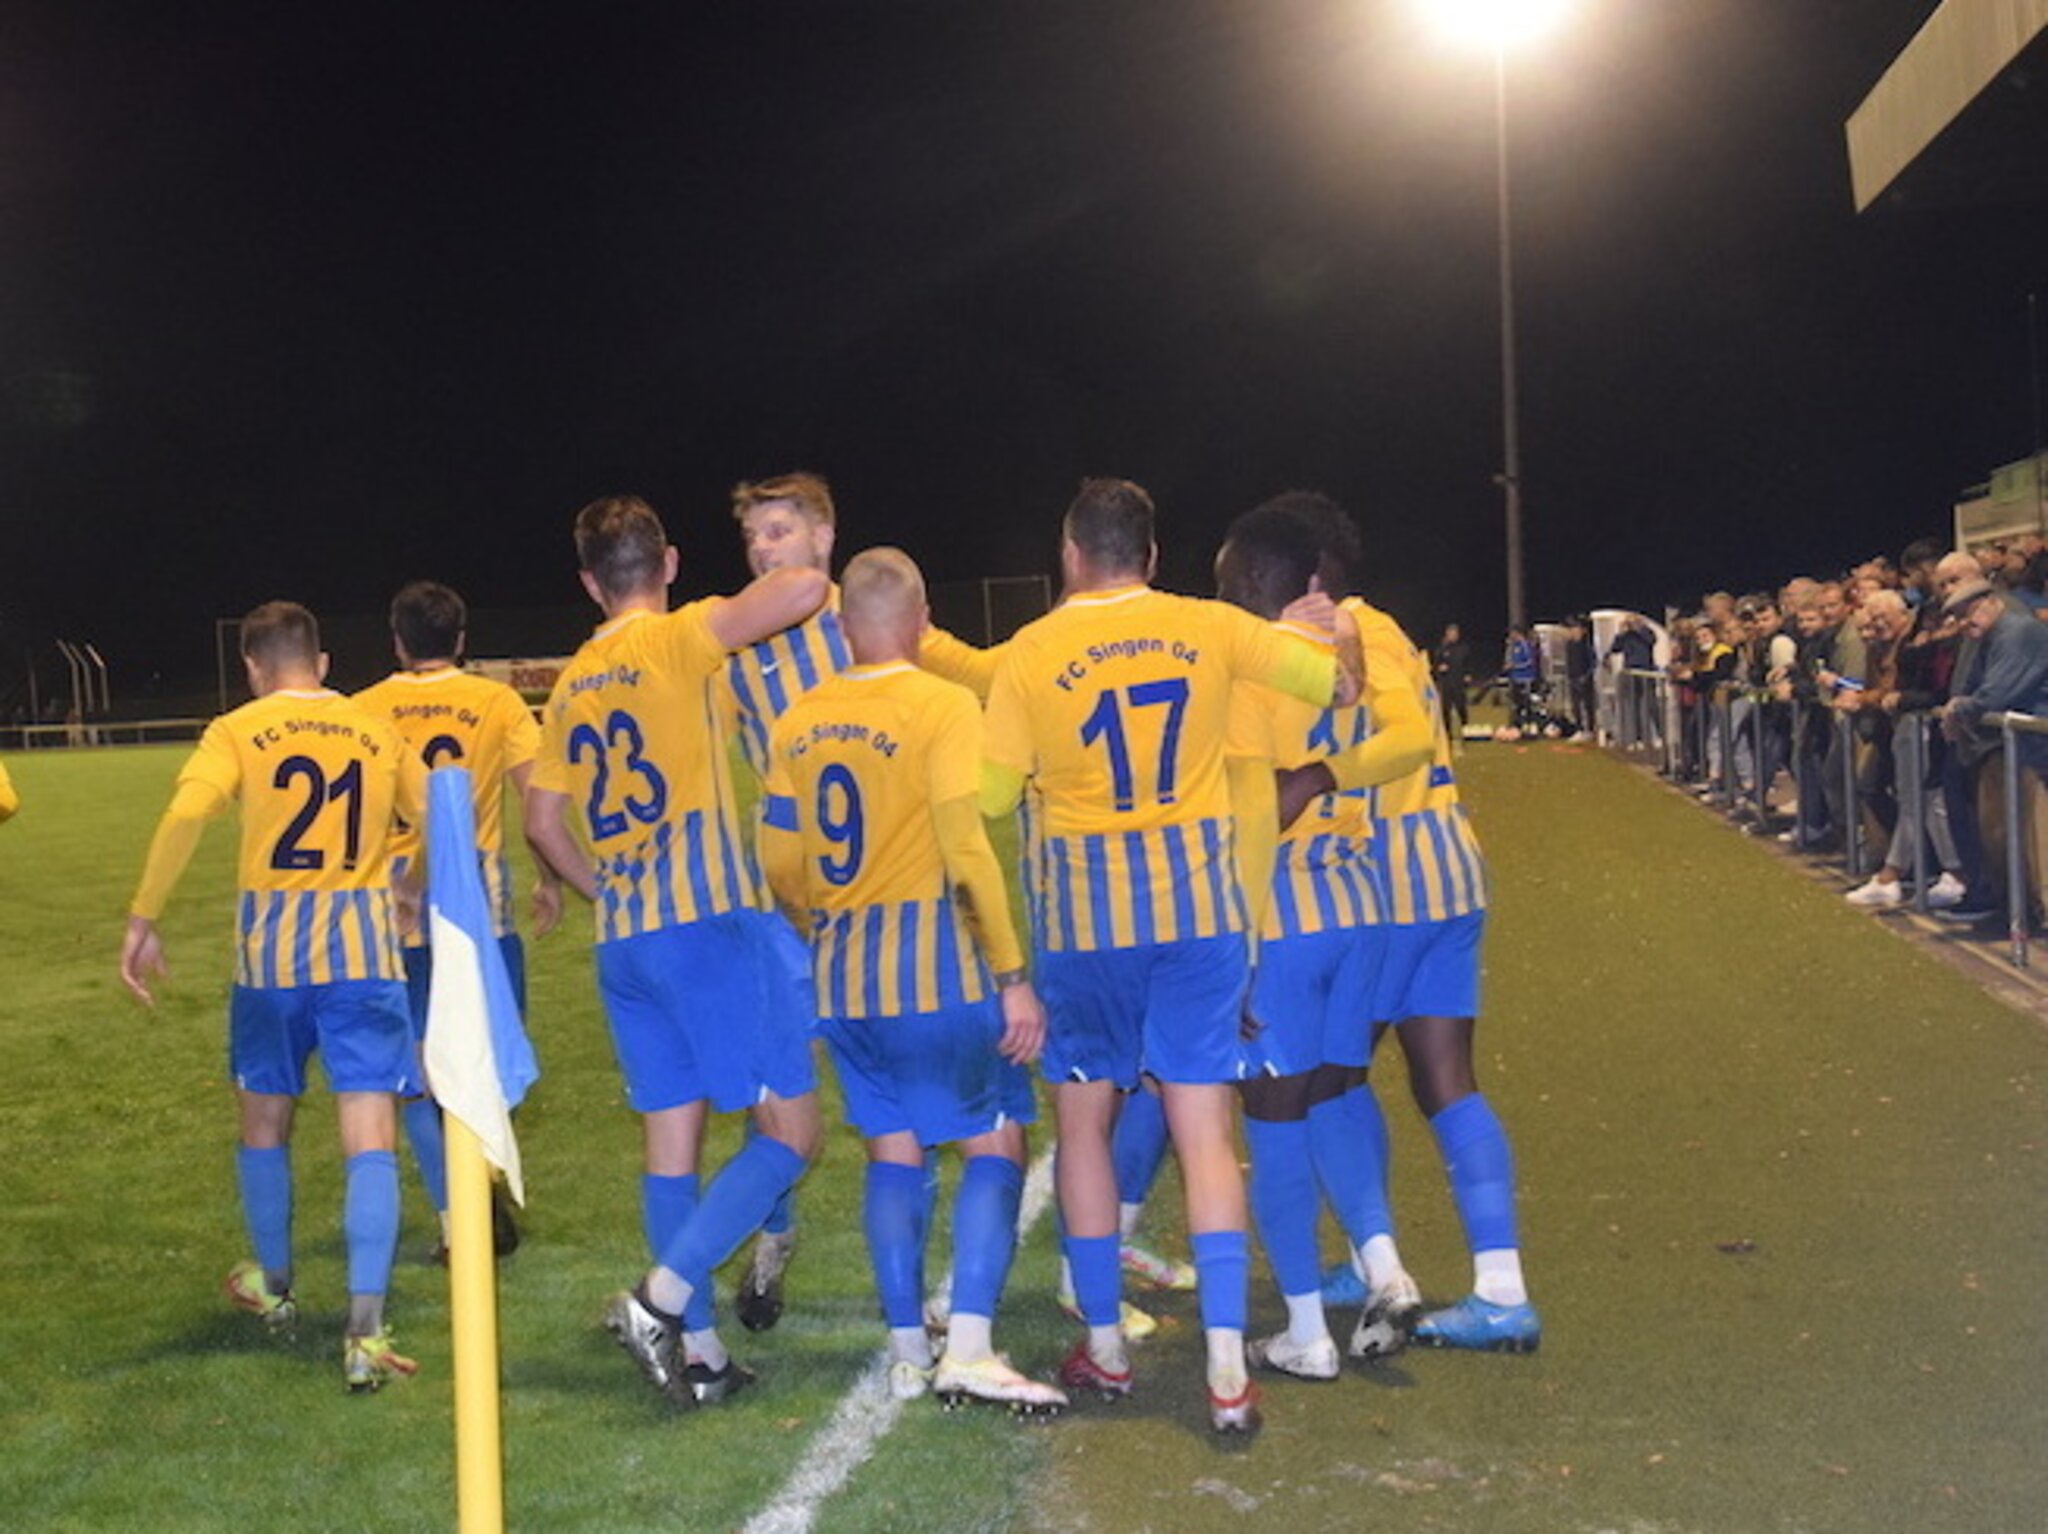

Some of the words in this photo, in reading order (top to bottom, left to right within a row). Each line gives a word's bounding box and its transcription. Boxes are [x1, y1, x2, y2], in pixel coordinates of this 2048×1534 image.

[1056, 660, 1086, 691] FC
[1087, 637, 1164, 664] Singen
[1172, 640, 1198, 666] 04
[253, 727, 280, 751] FC
[285, 718, 353, 735] Singen
[359, 733, 380, 757] 04
[392, 704, 452, 719] Singen
[457, 707, 479, 729] 04
[811, 722, 868, 743] Singen
[872, 731, 898, 757] 04
[1080, 677, 1189, 812] 17
[270, 754, 362, 871] 21
[568, 709, 666, 841] 23
[817, 762, 864, 887] 9
